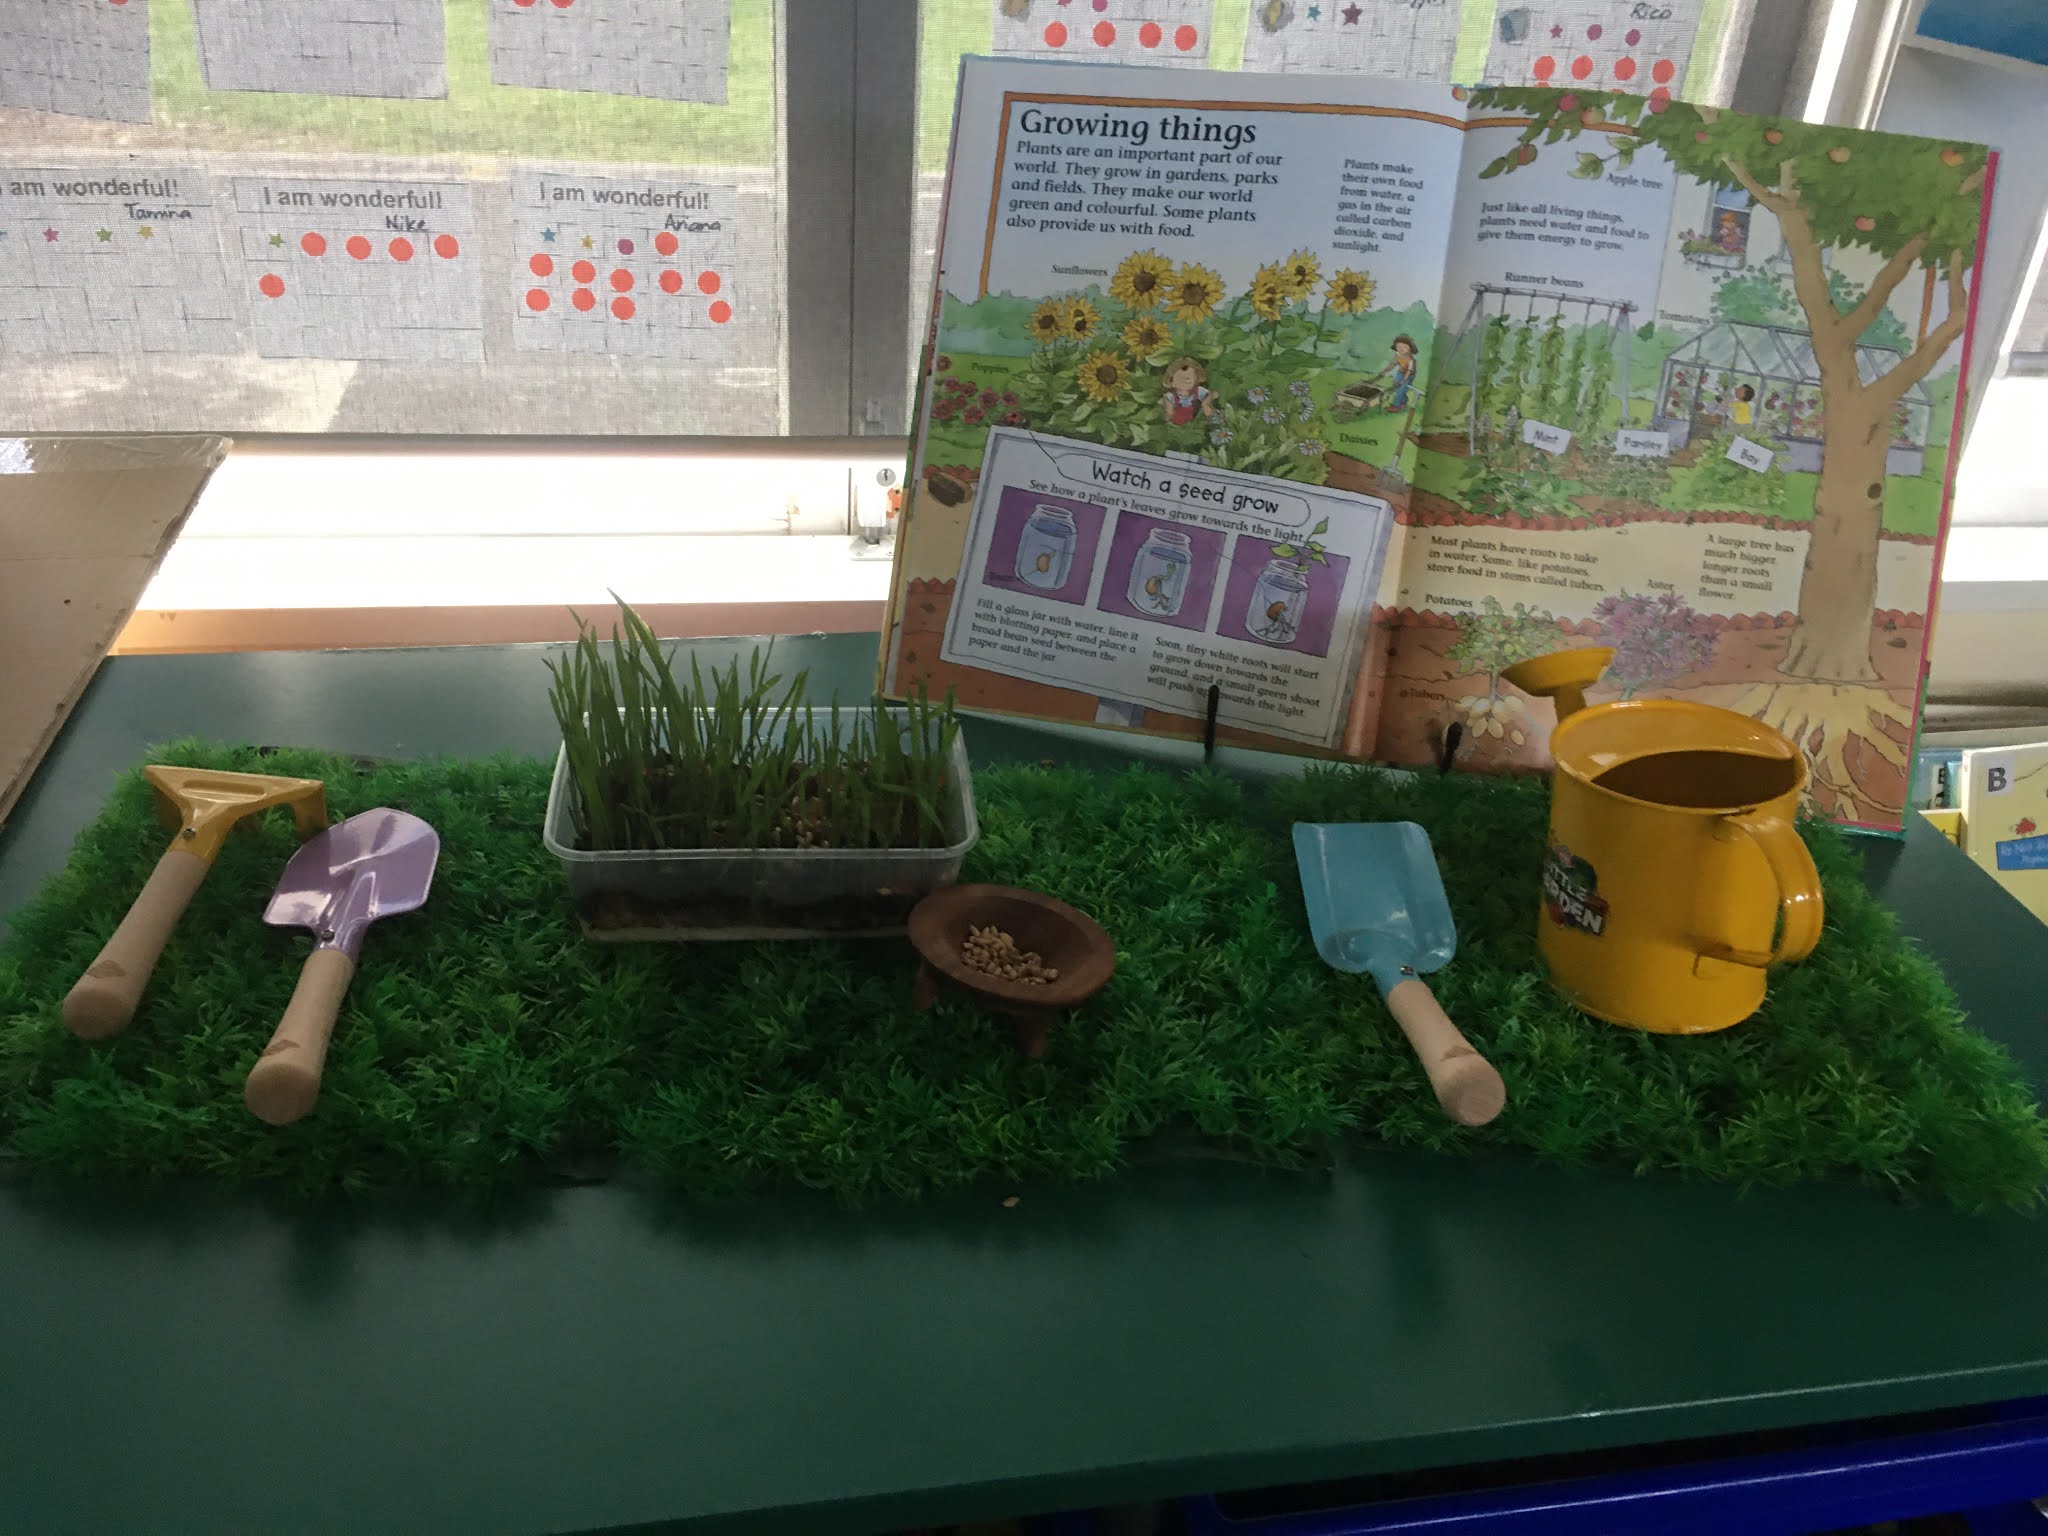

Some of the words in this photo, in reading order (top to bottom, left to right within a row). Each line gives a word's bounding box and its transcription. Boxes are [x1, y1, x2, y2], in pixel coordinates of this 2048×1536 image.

[1630, 2, 1673, 20] Rico
[1020, 109, 1149, 146] Growing
[1160, 116, 1256, 150] things
[1016, 140, 1062, 156] Plants
[1066, 146, 1090, 158] are
[1094, 147, 1113, 160] an
[1119, 146, 1195, 163] important
[1199, 151, 1231, 165] part
[1236, 151, 1253, 165] of
[1256, 154, 1283, 166] our
[1014, 160, 1058, 175] world.
[1065, 161, 1100, 180] They
[1104, 167, 1142, 181] grow
[1147, 166, 1161, 179] in
[1166, 167, 1229, 185] gardens,
[1235, 169, 1279, 187] parks
[1344, 159, 1379, 171] Plants
[1382, 164, 1414, 175] make
[10, 181, 46, 197] am
[52, 177, 179, 198] wonderful!
[1011, 178, 1040, 192] and
[1044, 179, 1086, 194] fields.
[1092, 182, 1127, 201] They
[1132, 184, 1173, 199] make
[1178, 189, 1205, 201] our
[1208, 188, 1253, 203] world
[1340, 185, 1367, 198] from
[1342, 172, 1369, 184] their
[1371, 177, 1396, 187] own
[1399, 178, 1424, 190] food
[1607, 173, 1639, 187] Apple
[1641, 178, 1664, 190] tree
[263, 186, 271, 206] I
[278, 191, 313, 207] am
[319, 189, 442, 210] wonderful!
[540, 181, 546, 201] I
[552, 187, 585, 202] am
[592, 188, 710, 211] wonderful!
[1009, 198, 1049, 213] green
[1054, 199, 1083, 213] and
[1087, 201, 1157, 217] colourful.
[1163, 204, 1204, 219] Some
[1208, 206, 1256, 223] plants
[1338, 201, 1357, 212] gas
[1374, 202, 1393, 213] the
[1395, 206, 1412, 215] air
[1481, 202, 1503, 215] Just
[1506, 202, 1529, 213] like
[1531, 204, 1547, 214] all
[1550, 204, 1584, 220] living
[664, 213, 721, 232] Ariana
[1006, 215, 1036, 229] also
[1039, 218, 1095, 233] provide
[1100, 223, 1116, 234] us
[1120, 221, 1153, 236] with
[1158, 223, 1195, 239] food.
[1336, 213, 1370, 225] called
[1372, 217, 1412, 229] carbon
[1480, 216, 1516, 228] plants
[1519, 219, 1547, 229] need
[1550, 221, 1582, 232] water
[1585, 224, 1608, 235] and
[1610, 226, 1636, 239] food
[1381, 232, 1404, 242] and
[1477, 231, 1502, 243] give
[1504, 230, 1535, 241] them
[1538, 234, 1576, 248] energy
[1050, 264, 1108, 277] Sunflowers
[1505, 271, 1548, 285] Runner
[1550, 276, 1584, 289] beans
[1091, 460, 1151, 491] Watch
[1159, 479, 1171, 494] a
[1179, 481, 1226, 505] seed
[1232, 493, 1279, 515] grow
[1029, 479, 1049, 493] See
[1051, 483, 1075, 499] how
[1089, 492, 1128, 510] plant's
[1131, 499, 1166, 516] leaves
[1169, 507, 1199, 523] grow
[1202, 513, 1249, 533] towards
[1252, 523, 1271, 538] the
[1431, 535, 1458, 548] Most
[1461, 537, 1497, 551] plants
[1500, 542, 1527, 555] have
[1529, 548, 1557, 560] roots
[1559, 551, 1572, 561] to
[1573, 552, 1599, 564] take
[1703, 548, 1736, 560] much
[1704, 533, 1714, 544] A
[1717, 534, 1747, 549] large
[1750, 539, 1772, 551] tree
[1775, 541, 1795, 553] has
[1428, 549, 1441, 559] in
[1517, 557, 1538, 569] like
[1702, 560, 1738, 575] longer
[1741, 567, 1770, 577] roots
[1426, 563, 1455, 574] store
[1457, 564, 1483, 577] food
[1485, 568, 1497, 579] in
[1499, 570, 1531, 583] stems
[1533, 575, 1567, 588] called
[1700, 574, 1727, 586] than
[1741, 581, 1773, 592] small
[1425, 593, 1473, 608] Potatoes
[977, 598, 993, 609] Fill
[1004, 604, 1030, 617] glass
[1031, 608, 1047, 621] jar
[1049, 613, 1073, 627] with
[1108, 625, 1128, 638] line
[971, 622, 1001, 637] broad
[1003, 629, 1028, 643] bean
[1030, 635, 1053, 649] seed
[1055, 639, 1097, 658] between
[1100, 650, 1118, 662] the
[974, 611, 997, 624] with
[1000, 615, 1040, 635] blotting
[1075, 633, 1097, 646] and
[1099, 638, 1126, 653] place
[968, 636, 998, 650] paper
[1000, 643, 1021, 655] and
[1022, 645, 1040, 658] the
[1165, 653, 1191, 667] grow
[1194, 658, 1222, 673] down
[1226, 666, 1267, 682] towards
[1271, 674, 1289, 687] the
[1186, 643, 1207, 658] tiny
[1210, 649, 1239, 664] white
[1242, 657, 1268, 669] roots
[1271, 661, 1292, 675] will
[1294, 666, 1319, 681] start
[1147, 675, 1167, 687] will
[1168, 680, 1194, 694] push
[1258, 699, 1276, 712] the
[1192, 672, 1214, 684] and
[1225, 678, 1255, 693] small
[1257, 687, 1288, 702] green
[1290, 693, 1320, 708] shoot
[1988, 767, 2007, 793] B
